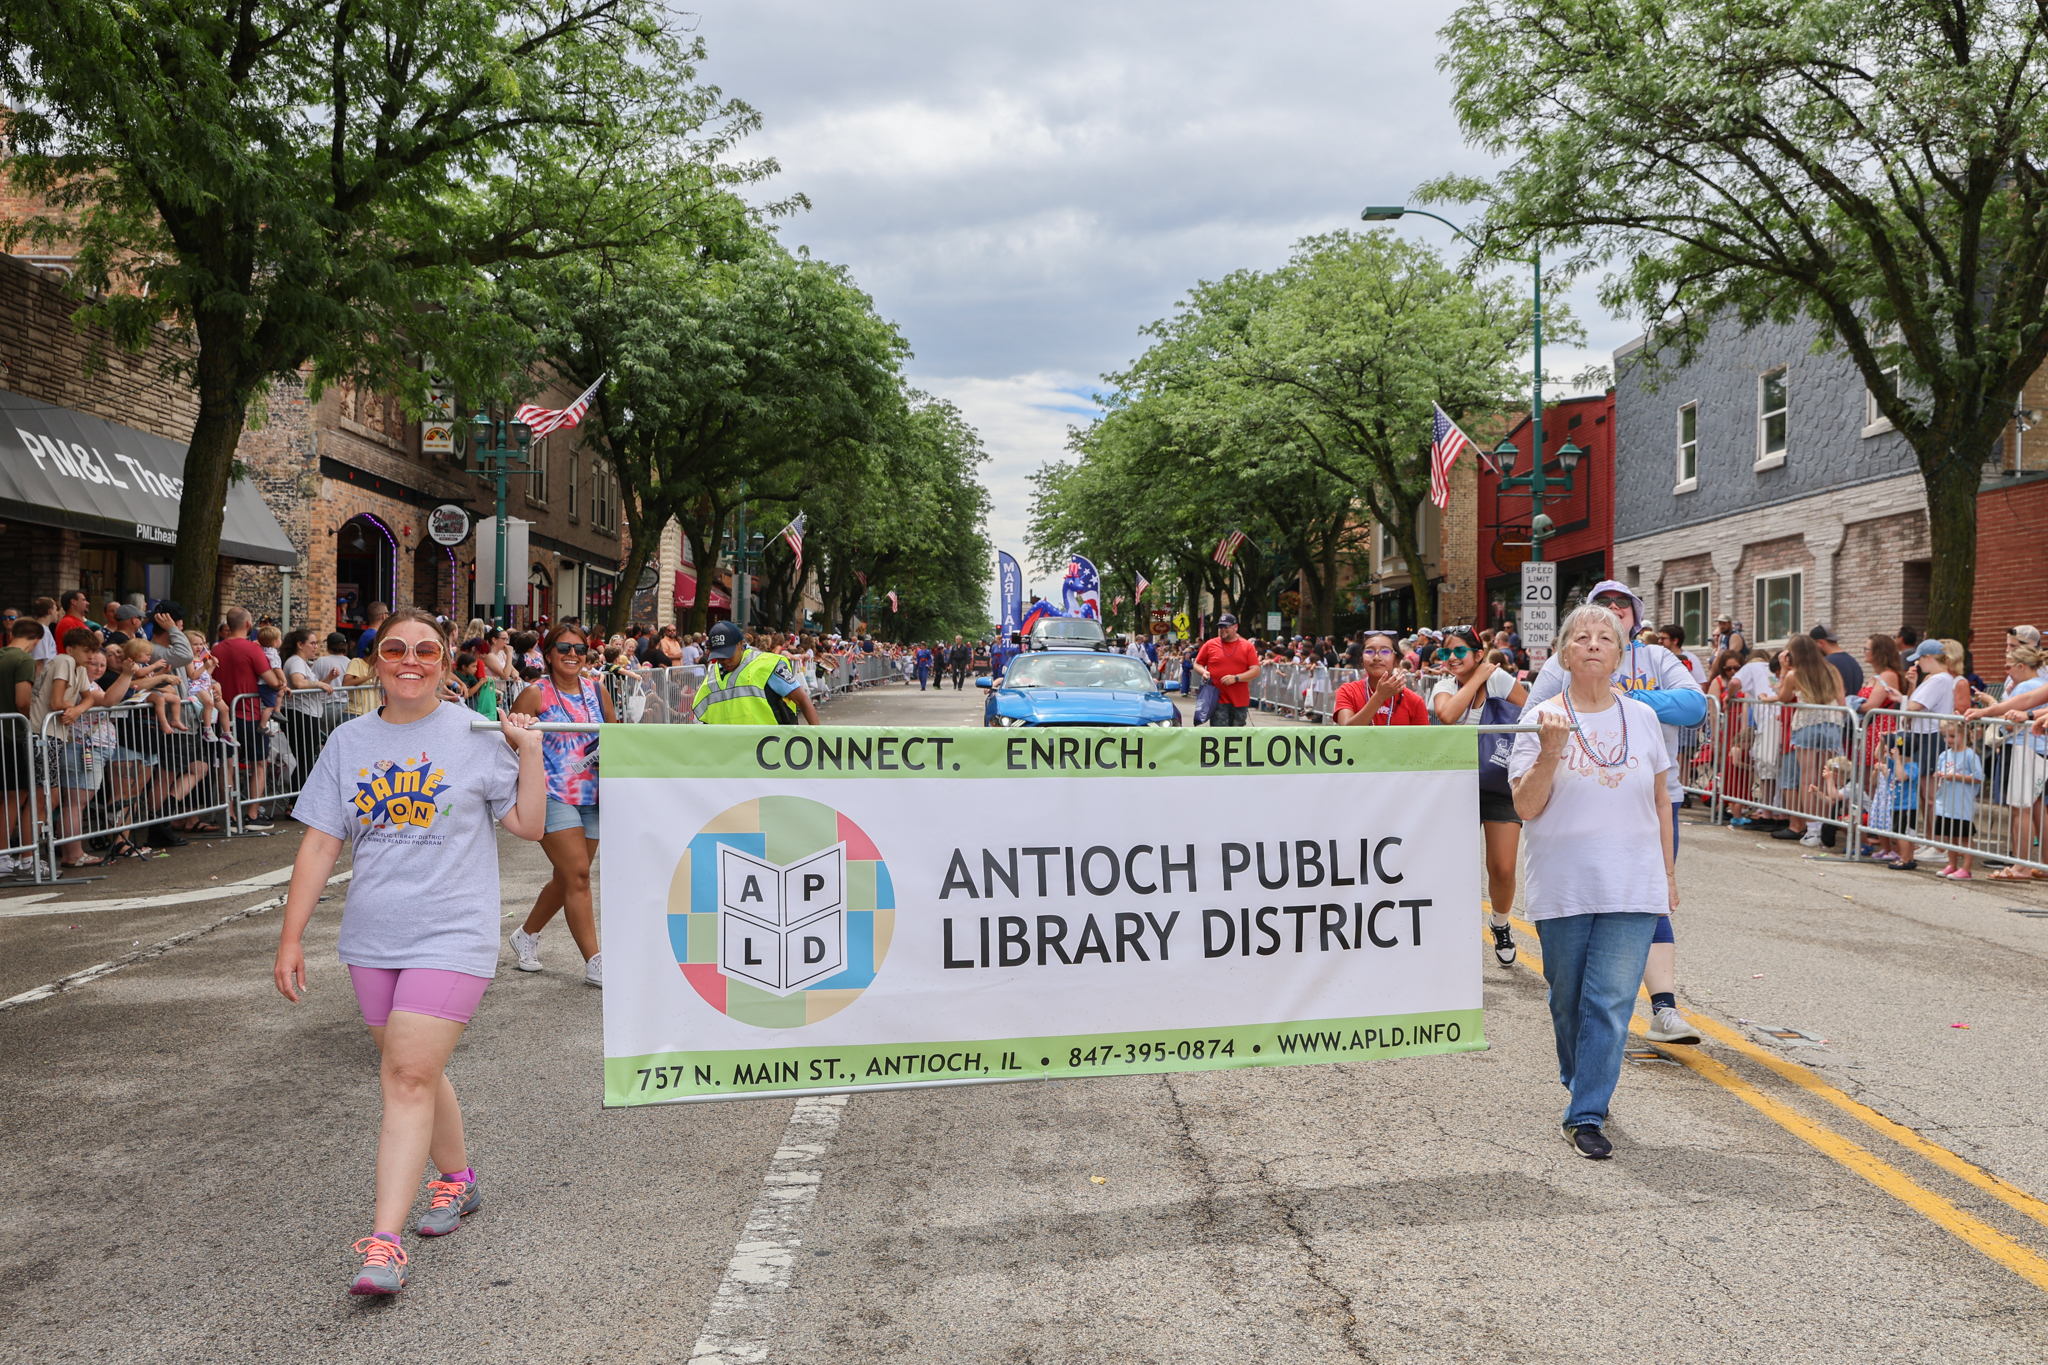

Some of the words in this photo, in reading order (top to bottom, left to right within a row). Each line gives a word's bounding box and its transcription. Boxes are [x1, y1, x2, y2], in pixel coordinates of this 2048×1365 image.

[15, 427, 130, 490] PM&L
[1525, 566, 1553, 574] SPEED
[1526, 585, 1552, 600] 20
[1524, 623, 1554, 631] SCHOOL
[1531, 611, 1546, 619] END
[1528, 634, 1549, 642] ZONE
[756, 735, 961, 771] CONNECT.
[1006, 736, 1157, 771] ENRICH.
[1199, 734, 1354, 768] BELONG.
[354, 770, 443, 813] GAME
[393, 803, 428, 821] ON
[938, 844, 1197, 900] ANTIOCH
[1221, 836, 1404, 891] PUBLIC
[740, 874, 764, 903] A
[803, 874, 825, 902] P
[943, 911, 1181, 969] LIBRARY
[1202, 899, 1433, 959] DISTRICT
[744, 937, 762, 966] L
[803, 936, 826, 964] D
[637, 1066, 684, 1091] 757
[694, 1064, 721, 1086] N.
[733, 1060, 799, 1086] MAIN
[809, 1058, 856, 1083] ST.,
[865, 1052, 990, 1077] ANTIOCH,
[1001, 1052, 1023, 1071] IL
[1068, 1038, 1235, 1068] 847-395-0874
[1277, 1022, 1461, 1055] WWW.APLD.INFO
